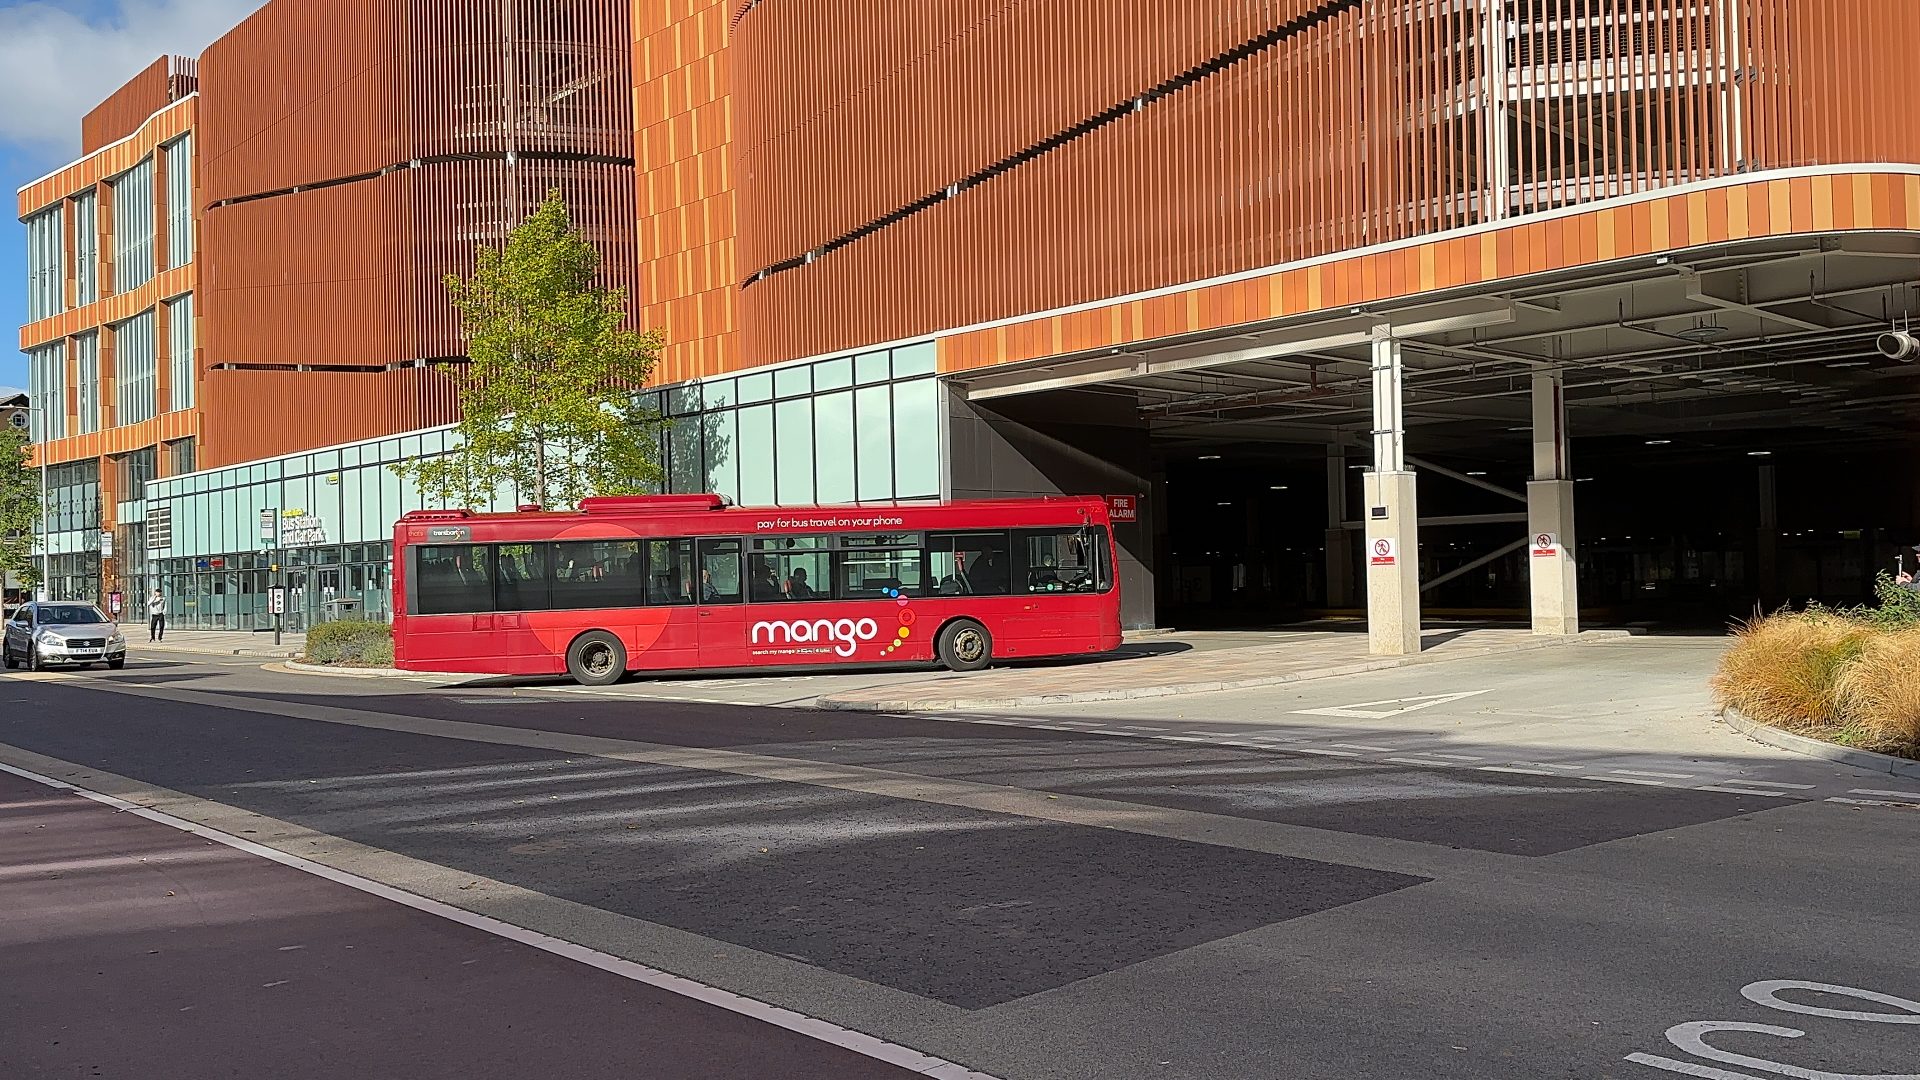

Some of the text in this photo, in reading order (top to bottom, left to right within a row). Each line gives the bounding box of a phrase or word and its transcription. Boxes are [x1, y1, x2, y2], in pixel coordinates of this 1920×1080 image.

[1113, 498, 1129, 508] FIRE
[1108, 509, 1135, 518] ALARM
[282, 517, 294, 531] Bus
[295, 515, 320, 530] Station
[757, 514, 903, 530] pay for bus travel on your phone
[282, 527, 325, 544] and Car Park
[751, 617, 878, 657] mango
